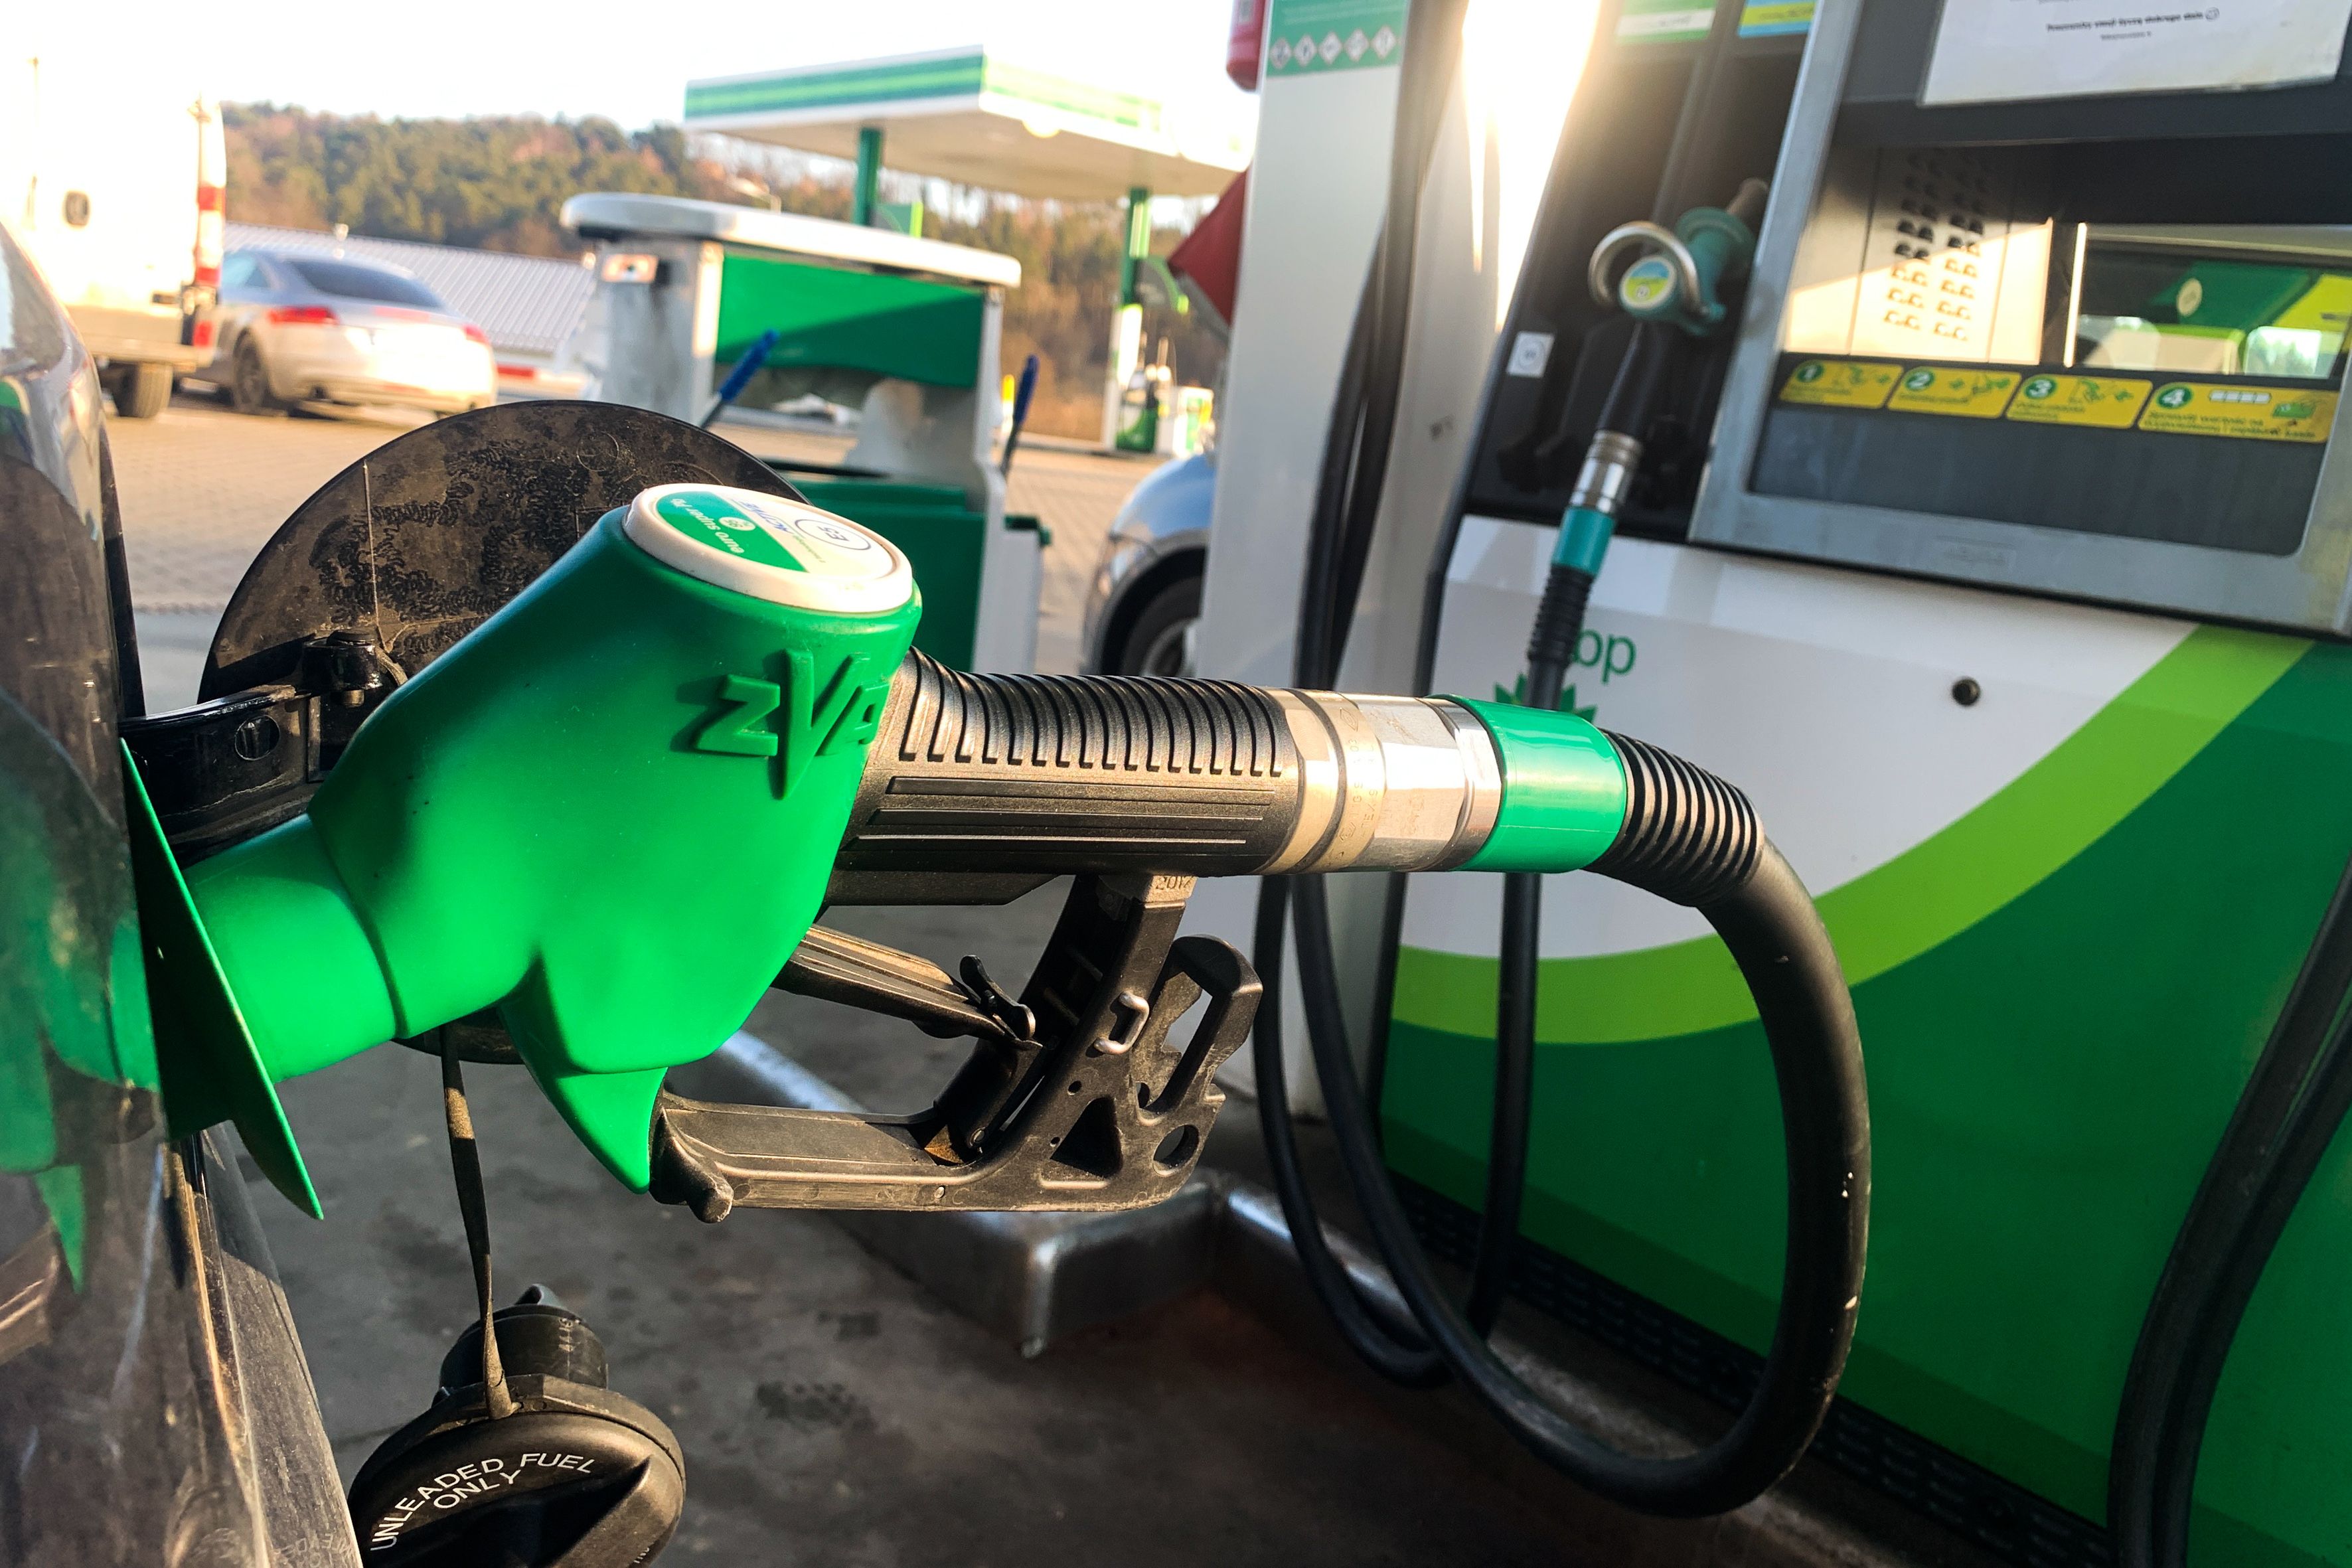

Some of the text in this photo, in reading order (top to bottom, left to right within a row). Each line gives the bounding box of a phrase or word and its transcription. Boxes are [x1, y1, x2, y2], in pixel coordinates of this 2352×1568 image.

[1804, 364, 1818, 382] 1
[1909, 372, 1930, 390] 2
[2029, 379, 2052, 398] 3
[2161, 389, 2185, 407] 4
[685, 508, 721, 530] super
[715, 532, 744, 554] euro
[433, 1469, 521, 1509] ONLY
[370, 1452, 595, 1551] UNLEADED FUEL
